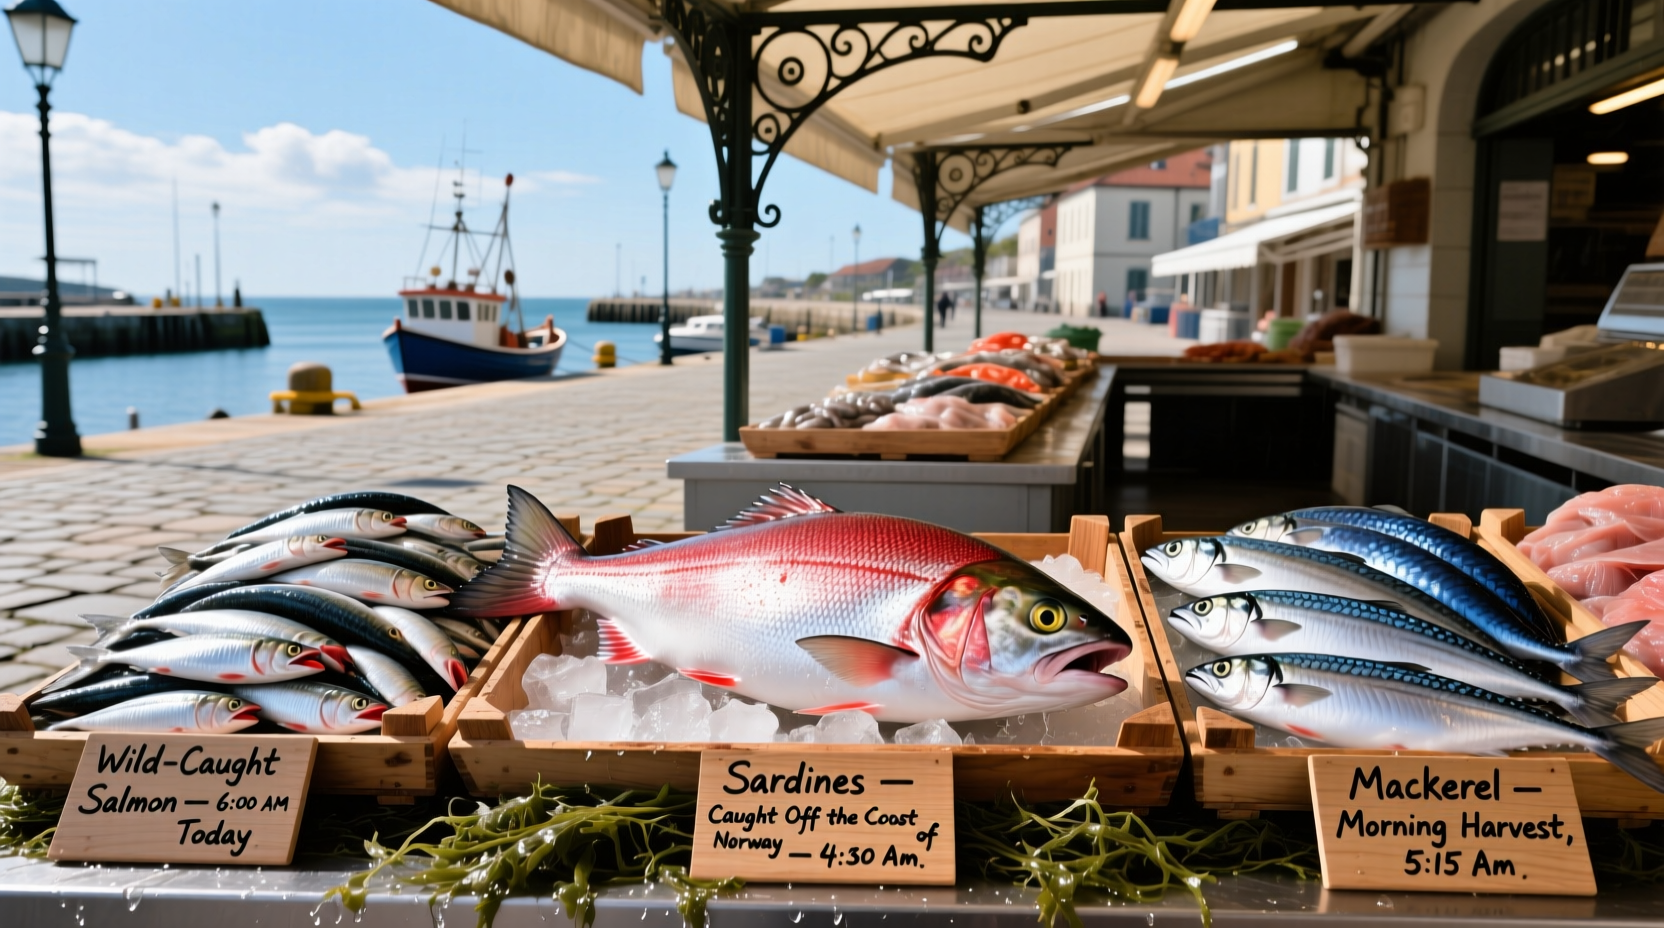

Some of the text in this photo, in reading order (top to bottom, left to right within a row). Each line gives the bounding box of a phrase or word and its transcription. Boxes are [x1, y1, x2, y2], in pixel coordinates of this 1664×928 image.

[97, 743, 281, 787] Wild-Caught
[722, 760, 865, 795] Sardines
[1349, 765, 1500, 801] Mackerel
[77, 783, 178, 815] Salmon
[216, 791, 258, 812] 6:00
[260, 795, 290, 812] AM
[177, 818, 253, 857] Today
[708, 804, 779, 832] Caught
[784, 805, 822, 835] Off
[826, 806, 858, 826] the
[916, 822, 940, 852] of
[1336, 809, 1574, 849] Morning Harvest,
[713, 830, 783, 859] Norway
[819, 842, 875, 868] 4:30
[1404, 849, 1462, 876] 5:15
